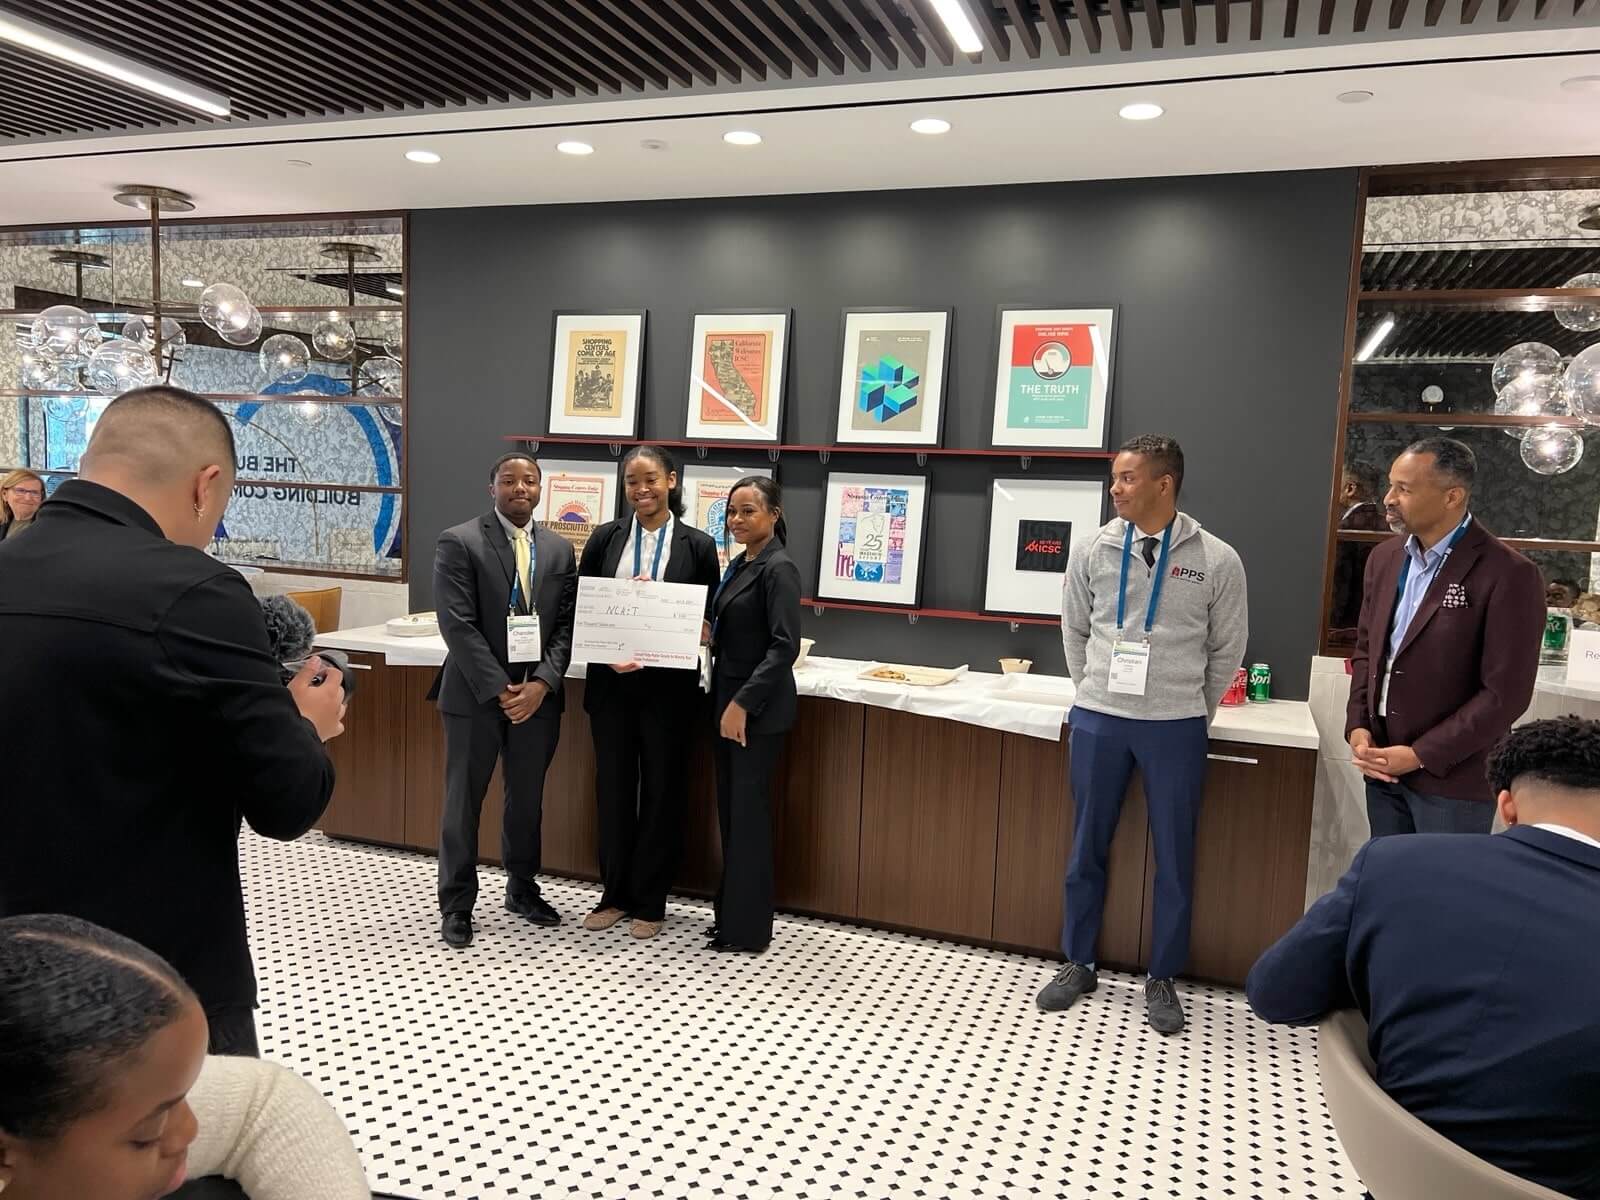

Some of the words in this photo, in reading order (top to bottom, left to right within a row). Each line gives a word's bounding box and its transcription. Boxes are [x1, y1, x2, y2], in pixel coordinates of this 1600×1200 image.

[604, 350, 616, 358] AGE
[1020, 384, 1041, 394] THE
[1044, 384, 1080, 394] TRUTH
[863, 533, 883, 551] 25
[1038, 545, 1062, 554] ICSC
